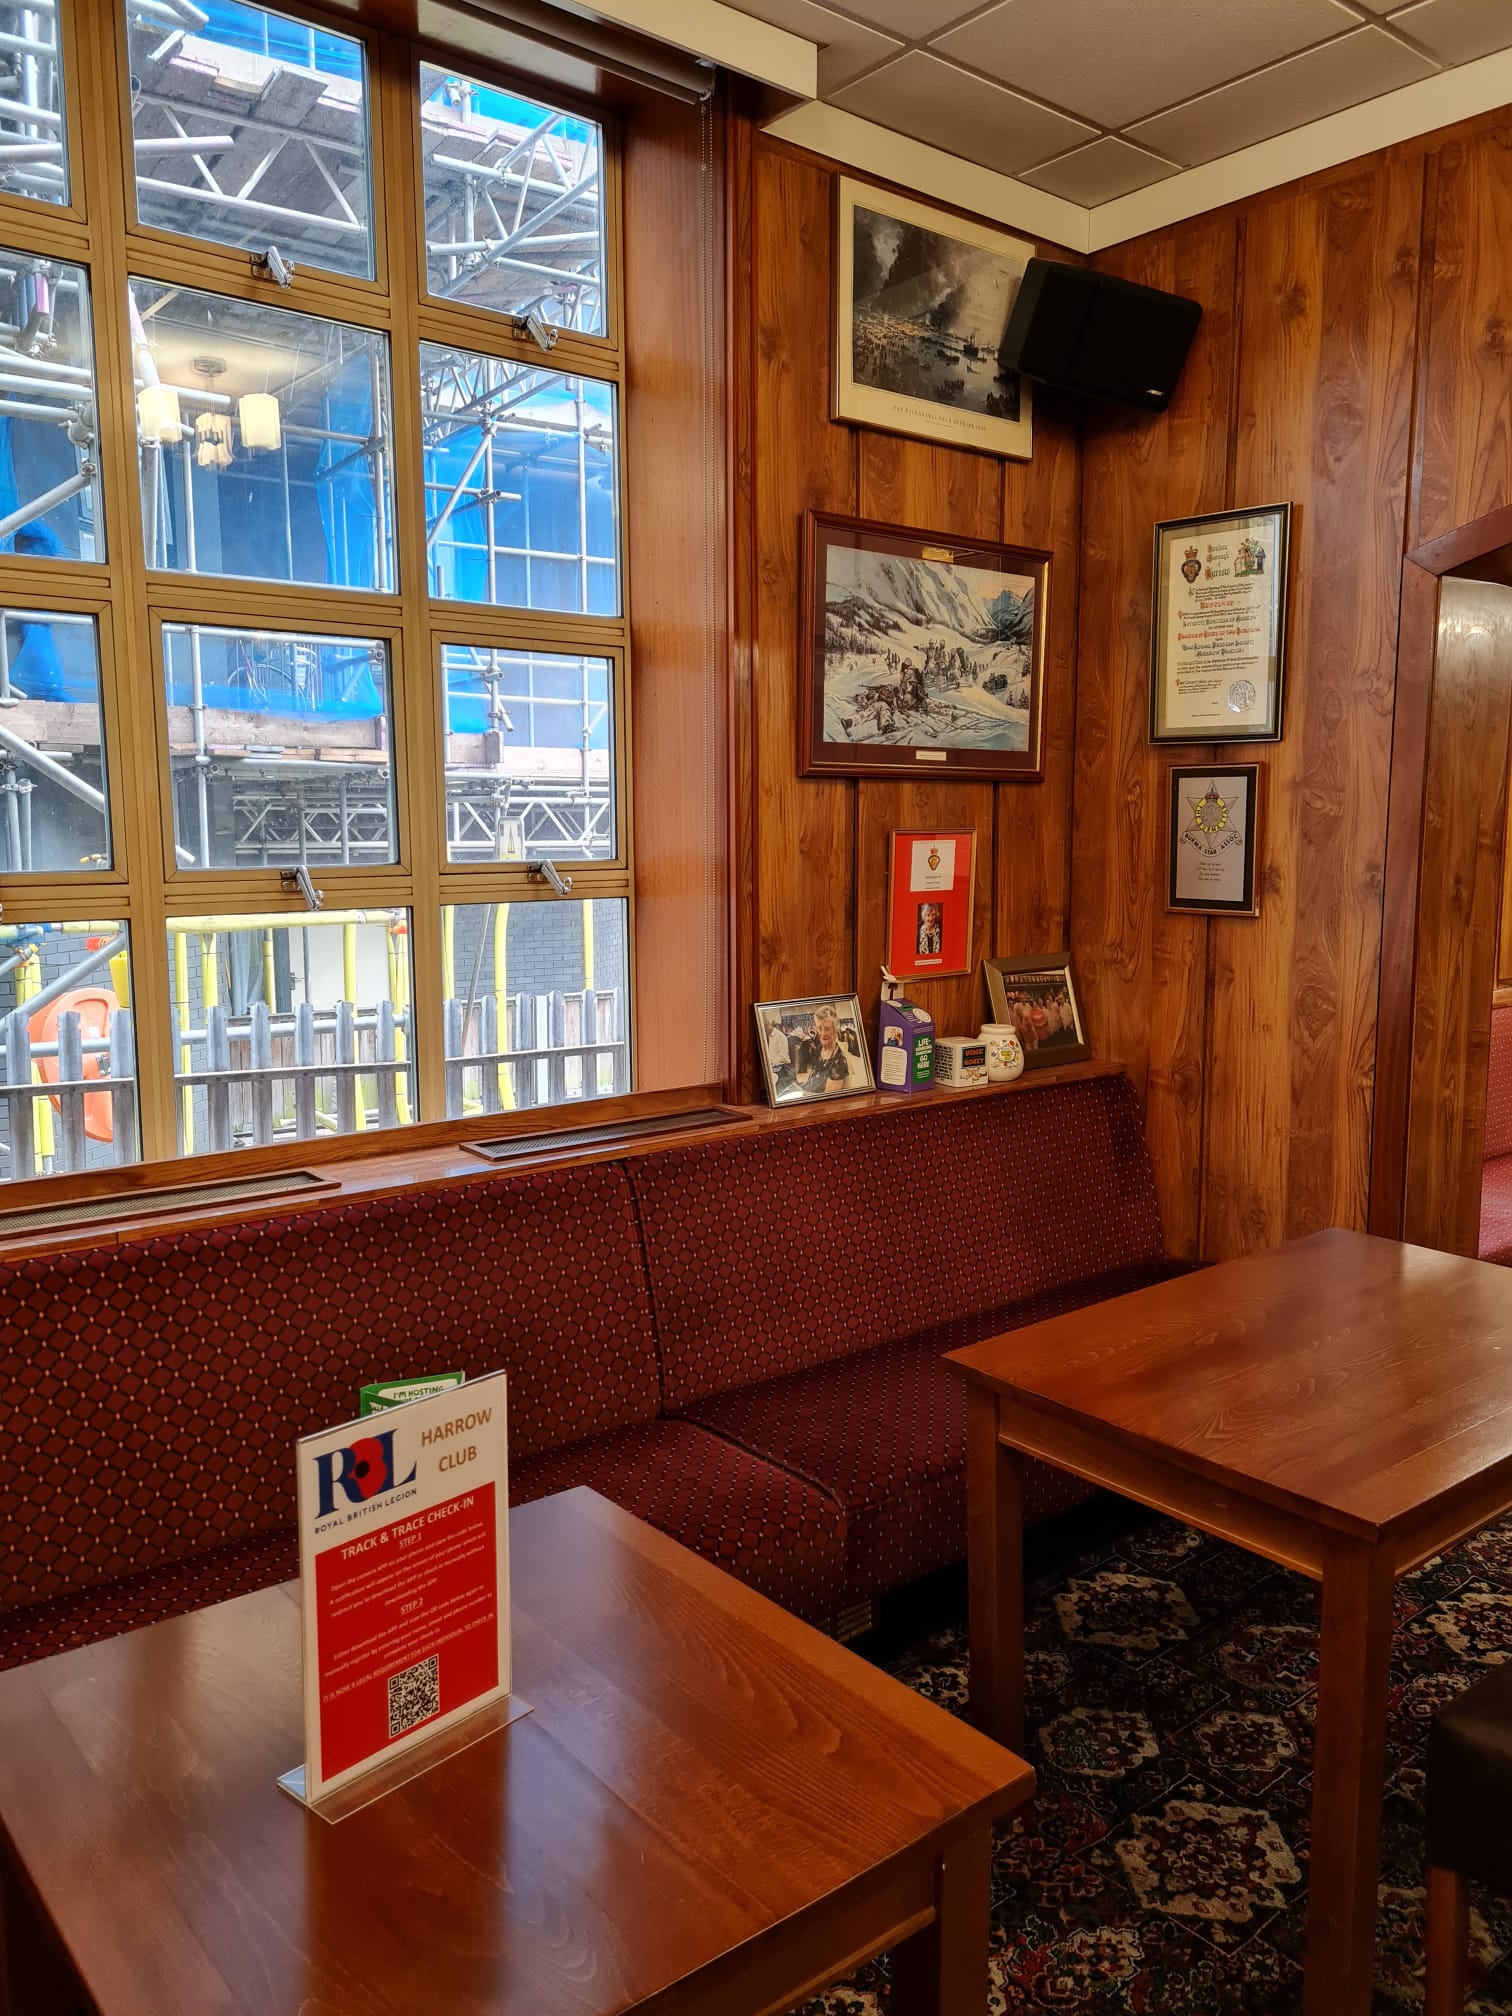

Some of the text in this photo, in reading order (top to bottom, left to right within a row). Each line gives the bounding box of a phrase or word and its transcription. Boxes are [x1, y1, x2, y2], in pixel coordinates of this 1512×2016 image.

[421, 1407, 493, 1447] HARROW
[438, 1446, 477, 1473] CLUB
[315, 1488, 417, 1535] ROYAL BRITISH LEGION
[341, 1496, 475, 1560] TRACK & TRACE CHECK-IN
[399, 1535, 416, 1548] STEP
[400, 1602, 417, 1615] STEP
